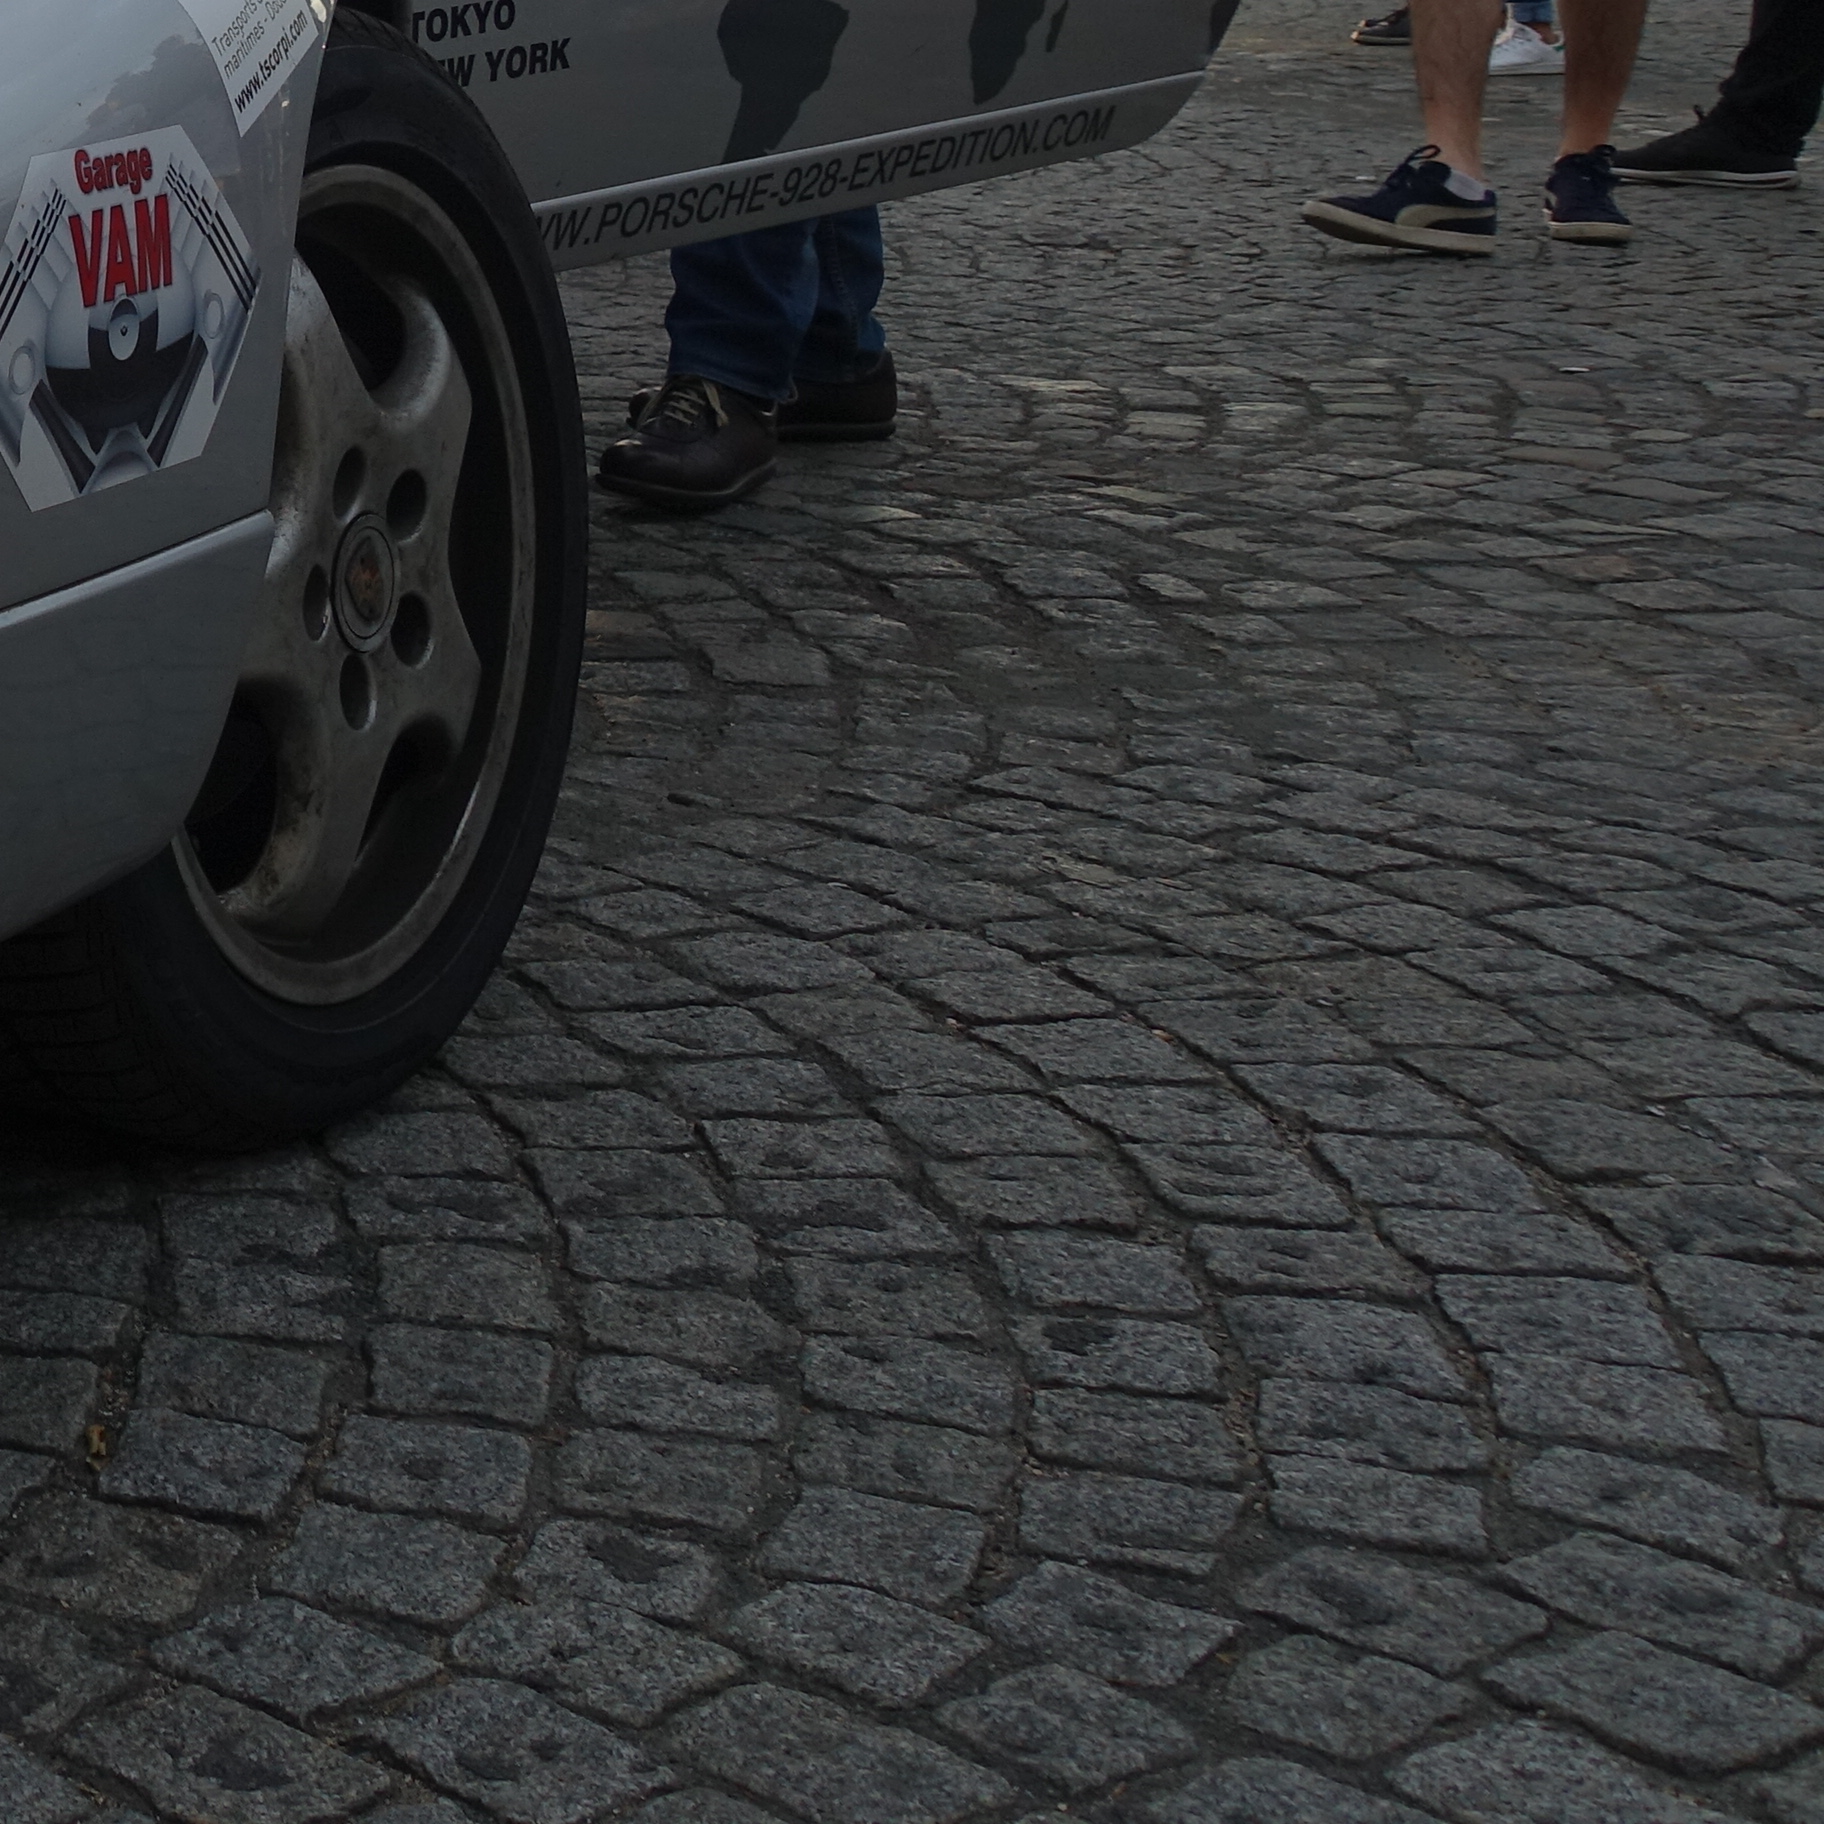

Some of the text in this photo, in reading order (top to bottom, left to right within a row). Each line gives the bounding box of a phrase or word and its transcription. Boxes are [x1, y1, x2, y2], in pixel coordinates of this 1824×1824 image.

[223, 20, 265, 79] maritimes
[234, 10, 308, 114] www.tscorpi.com
[485, 37, 571, 82] YORK
[74, 146, 153, 195] Garage
[68, 192, 173, 309] VAM
